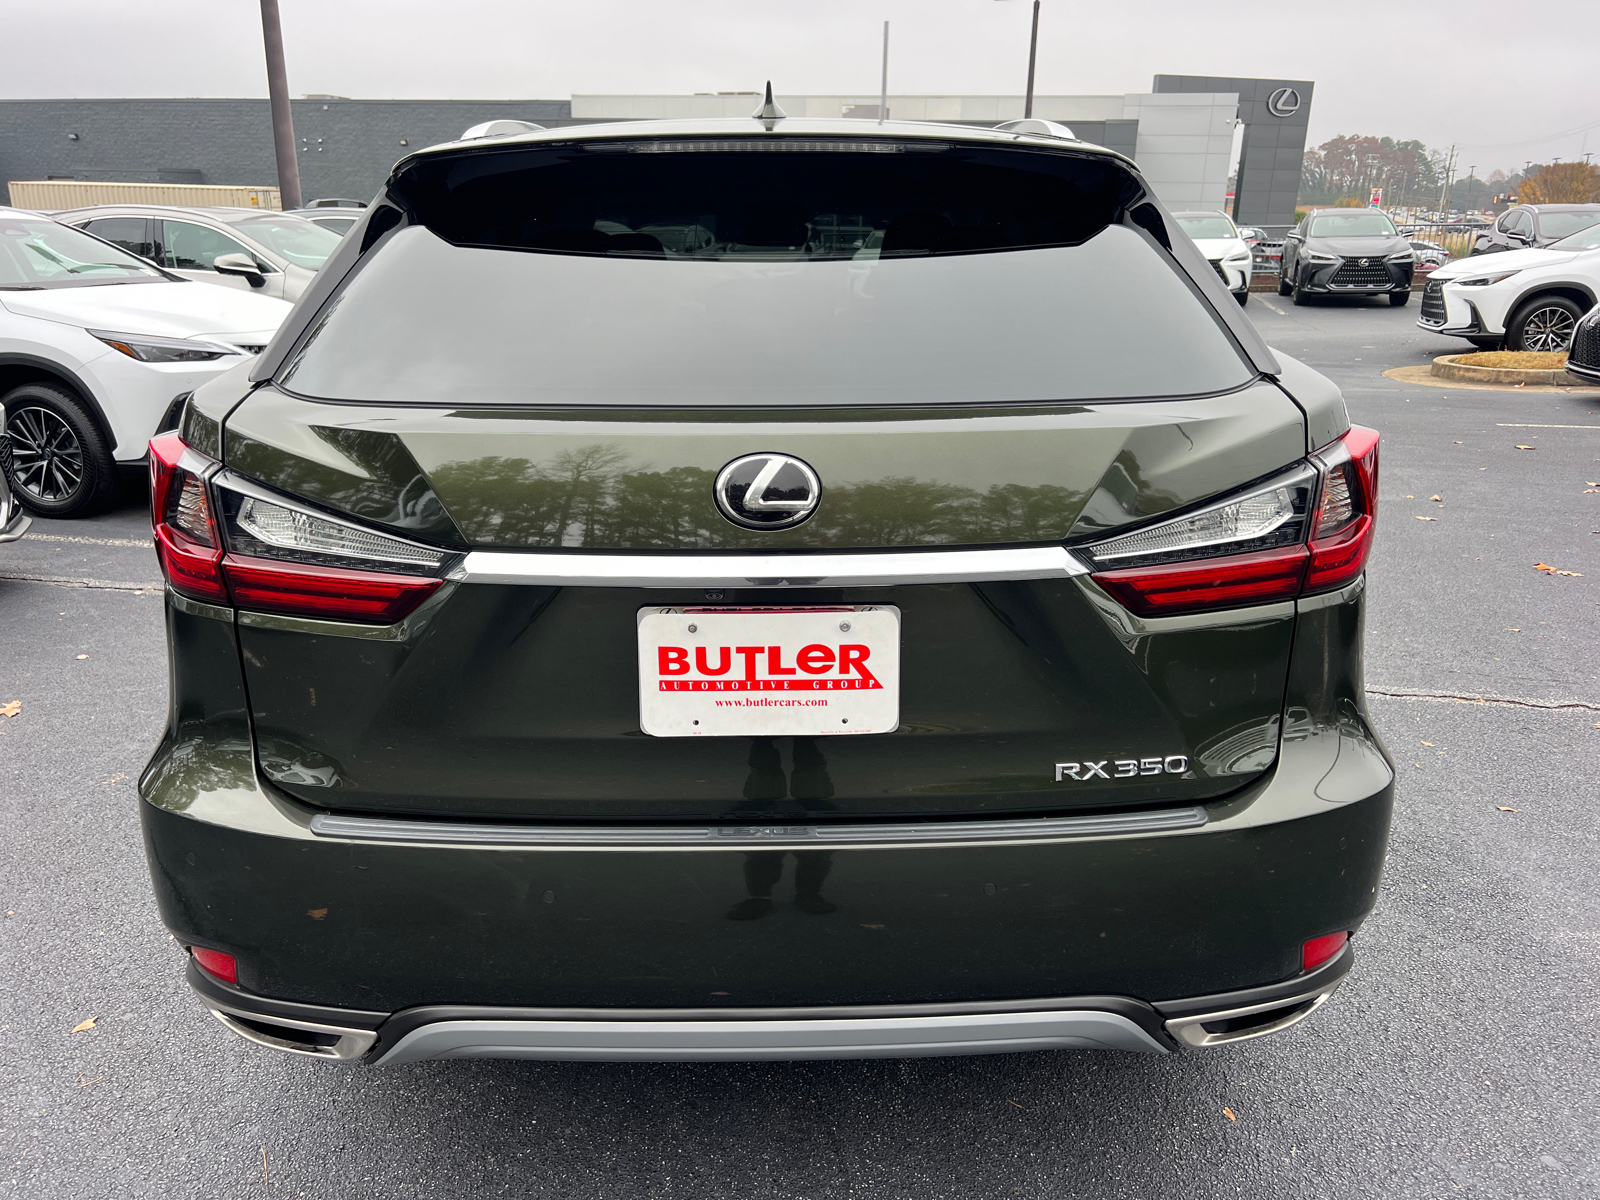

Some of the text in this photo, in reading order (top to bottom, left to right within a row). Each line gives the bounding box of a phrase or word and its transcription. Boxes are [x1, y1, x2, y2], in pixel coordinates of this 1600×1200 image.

[660, 679, 876, 691] AUTOMOTIVE GROUP
[715, 697, 828, 707] www.butlercars.com
[1055, 755, 1188, 782] RX 350
